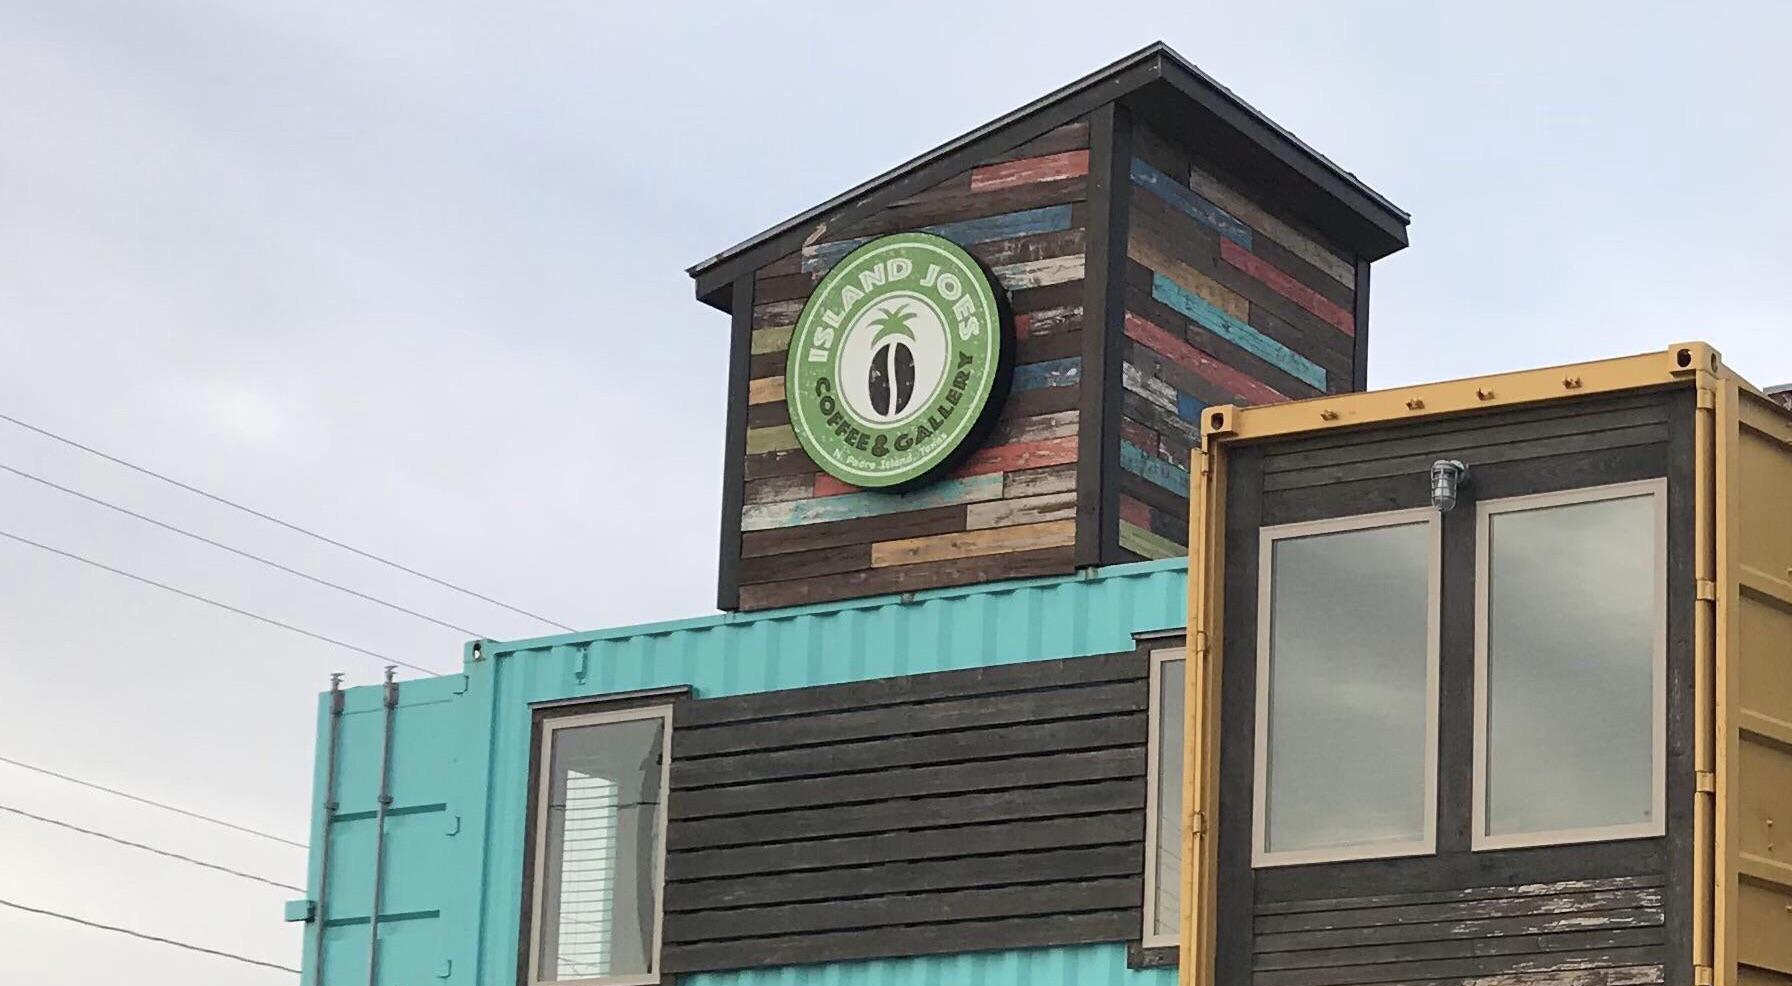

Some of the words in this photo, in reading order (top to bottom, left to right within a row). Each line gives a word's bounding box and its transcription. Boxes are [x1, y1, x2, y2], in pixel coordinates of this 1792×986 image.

[808, 258, 912, 362] ISLAND
[920, 264, 980, 341] JOES
[815, 377, 871, 451] COFFEE
[872, 435, 889, 457] &
[894, 351, 974, 452] GALLERY
[846, 455, 876, 470] Padre
